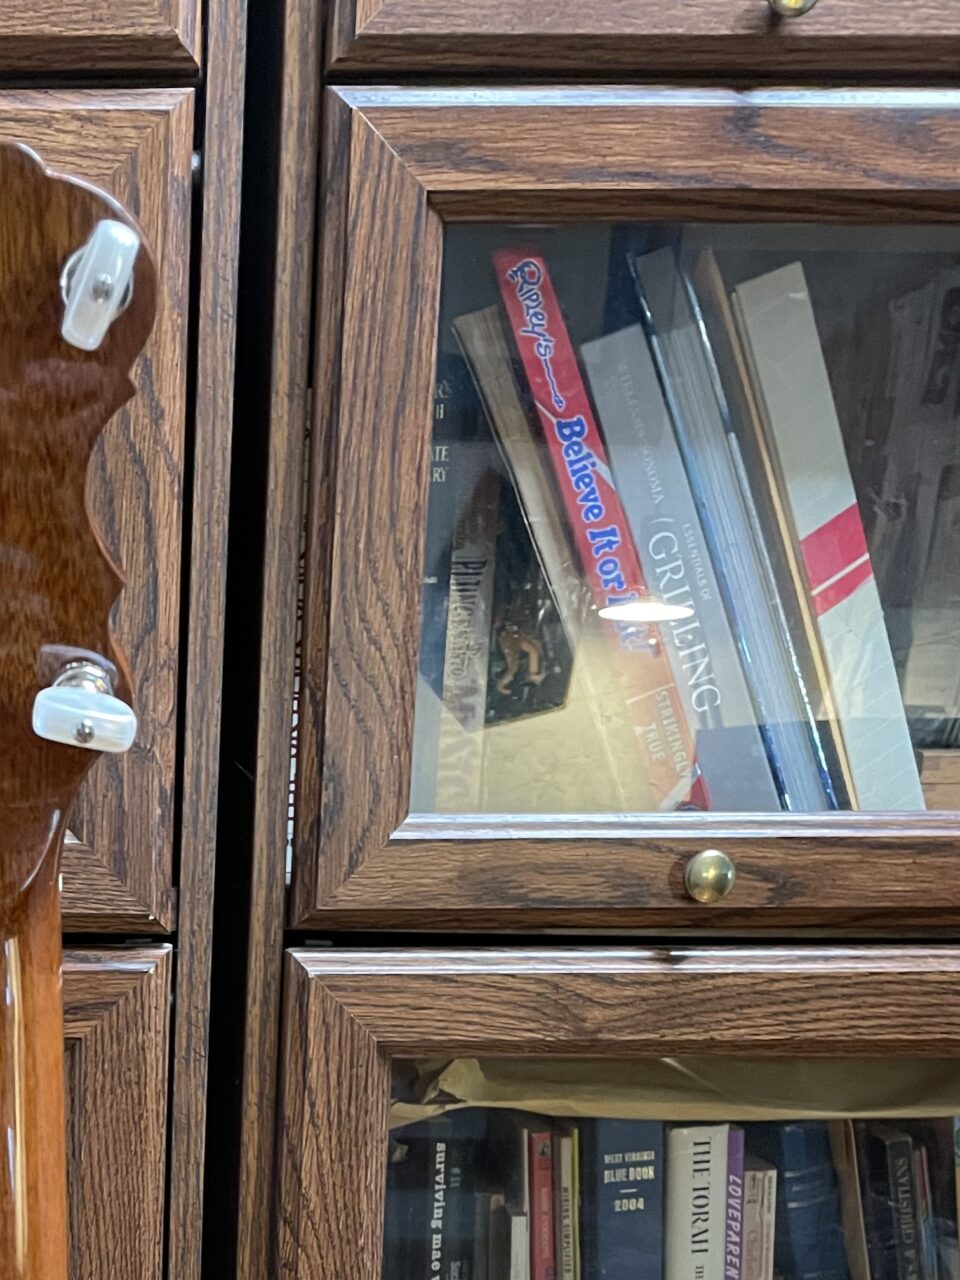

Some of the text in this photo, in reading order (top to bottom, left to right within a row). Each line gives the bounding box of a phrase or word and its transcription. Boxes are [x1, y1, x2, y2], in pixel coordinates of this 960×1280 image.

[555, 415, 626, 591] Believe It or
[642, 722, 665, 761] TRUE
[656, 690, 692, 779] STRIKINGLY
[431, 1142, 446, 1229] surviving
[604, 1150, 656, 1165] WEST VIRGINIA
[604, 1166, 655, 1184] BLUE BOOK
[691, 1136, 712, 1254] THE TORAH
[562, 1187, 572, 1274] WIRING SIMPLIFIED
[614, 1198, 645, 1212] 2004
[895, 1158, 915, 1243] CHRISTIANS
[431, 1233, 442, 1271] mae
